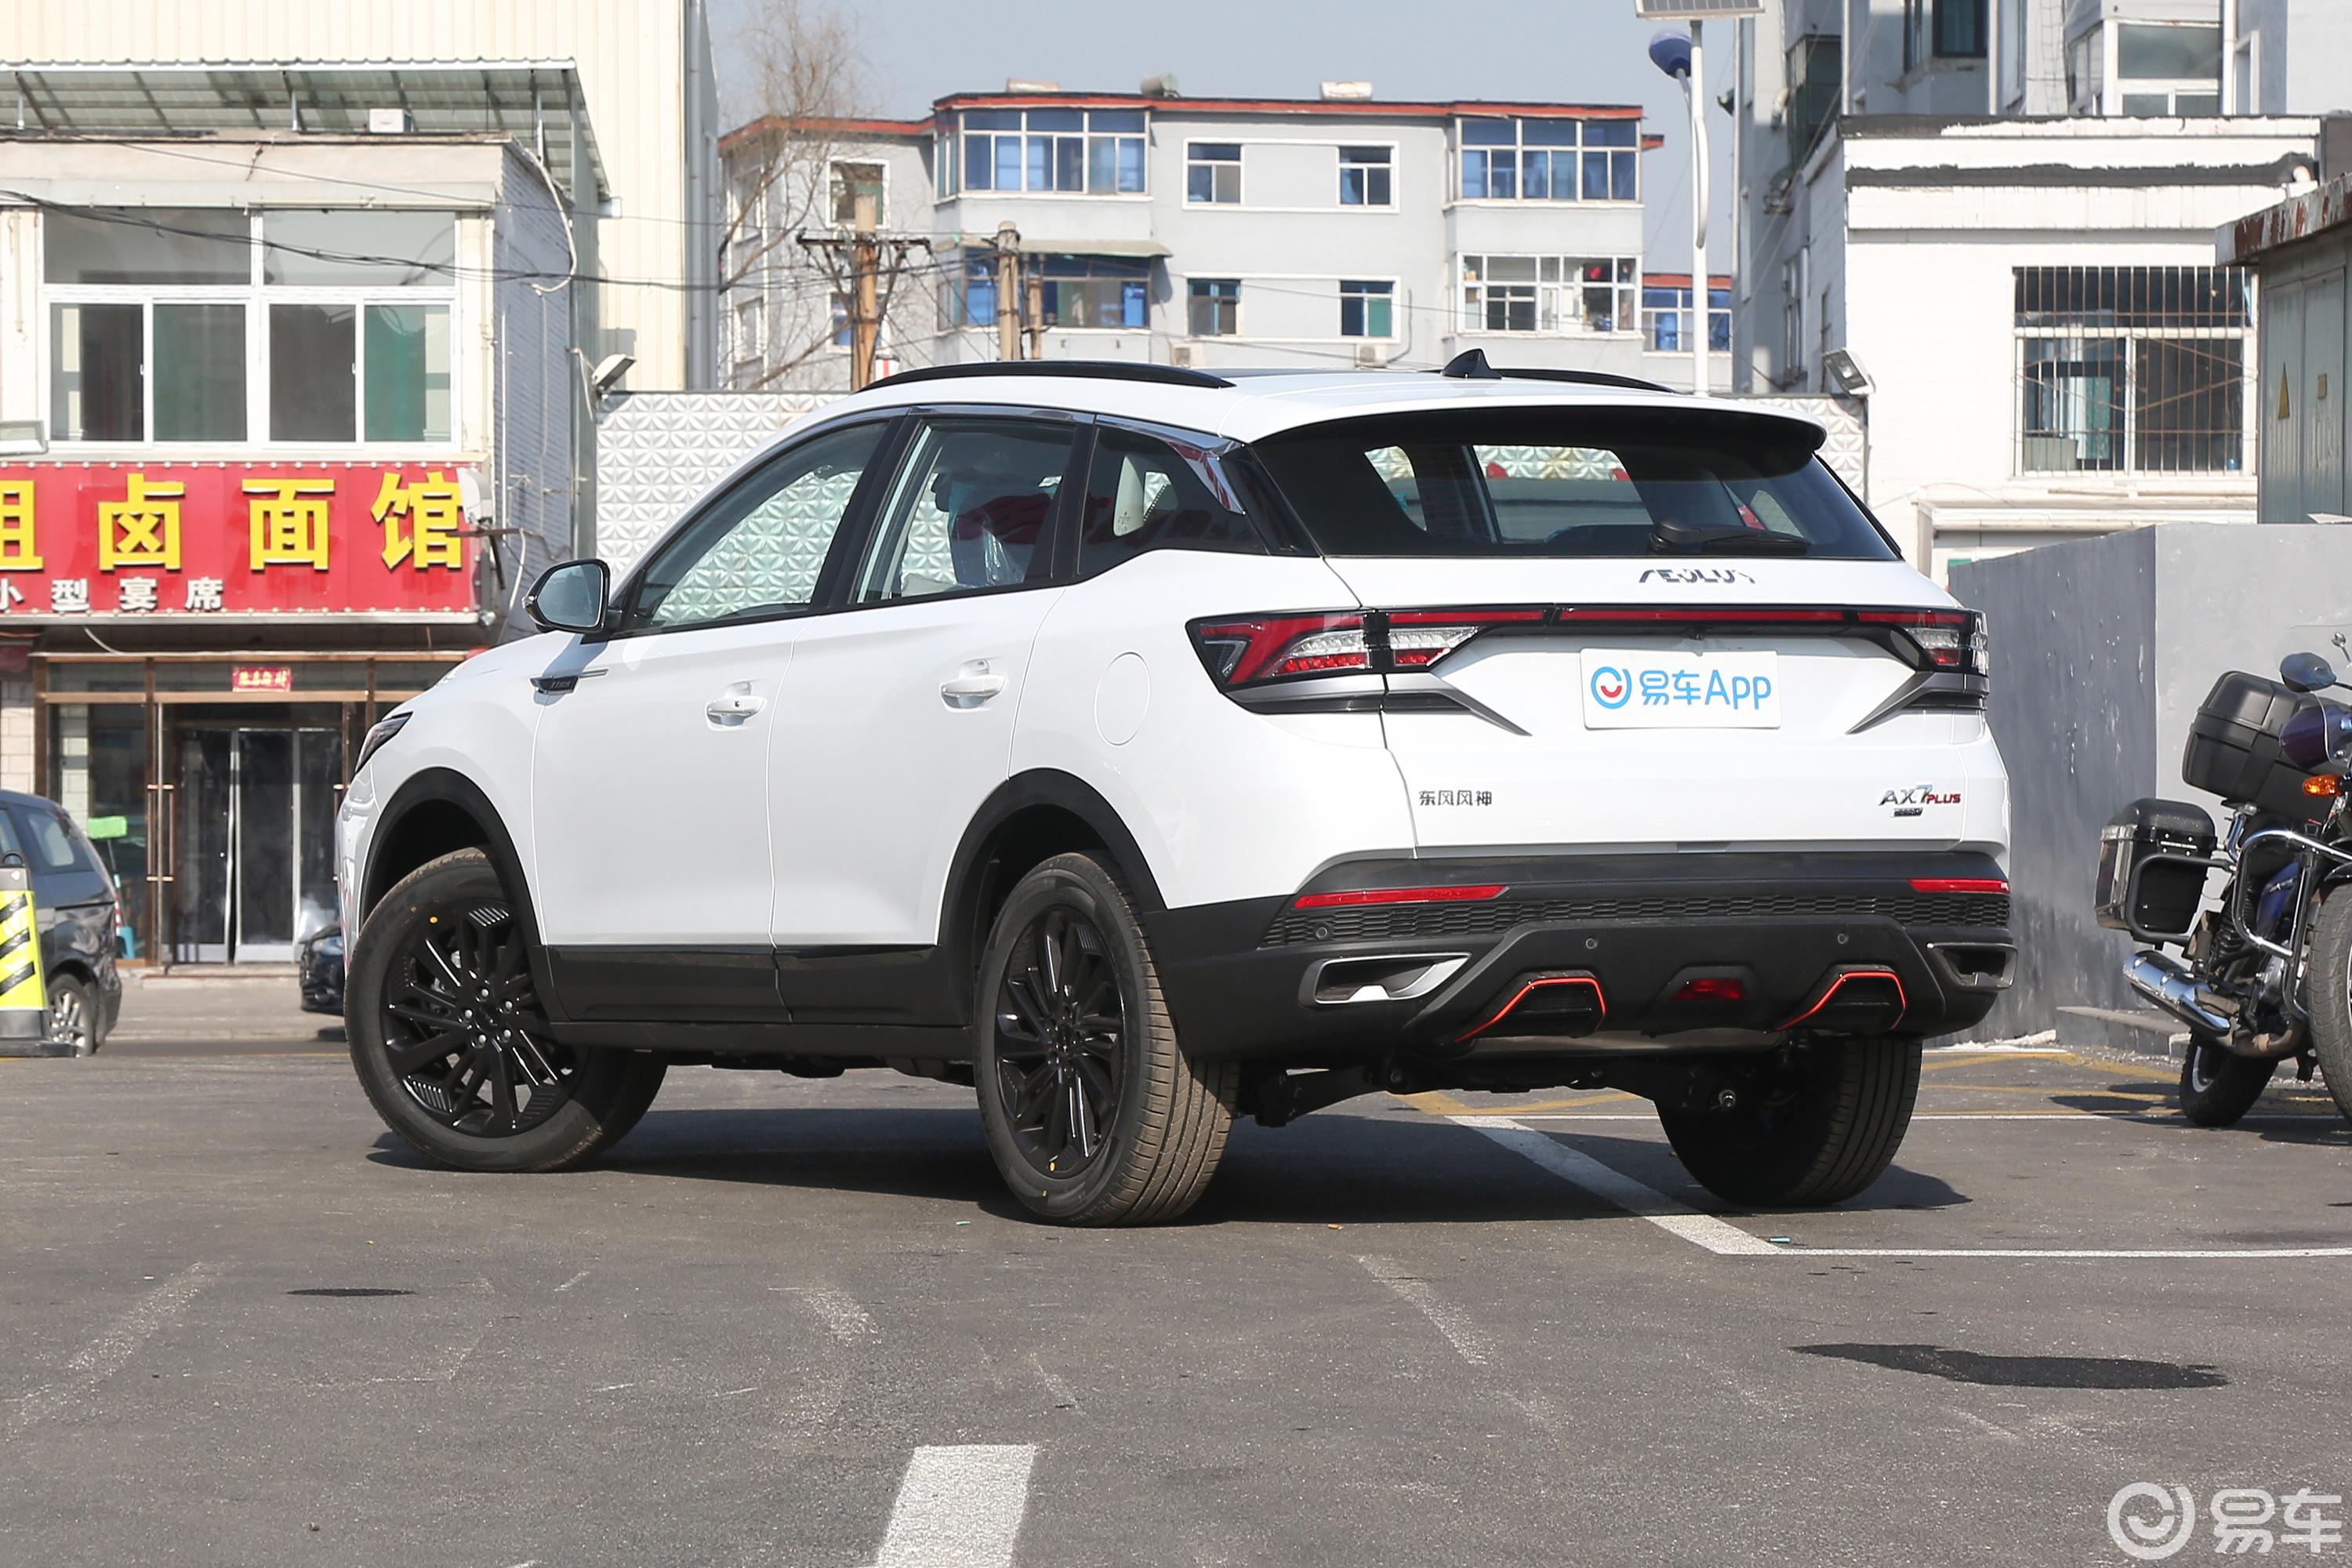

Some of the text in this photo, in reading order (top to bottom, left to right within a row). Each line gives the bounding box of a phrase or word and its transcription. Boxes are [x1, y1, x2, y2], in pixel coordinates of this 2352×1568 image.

[0, 577, 224, 612] 小型宴席
[1418, 789, 1493, 807] 东风风神
